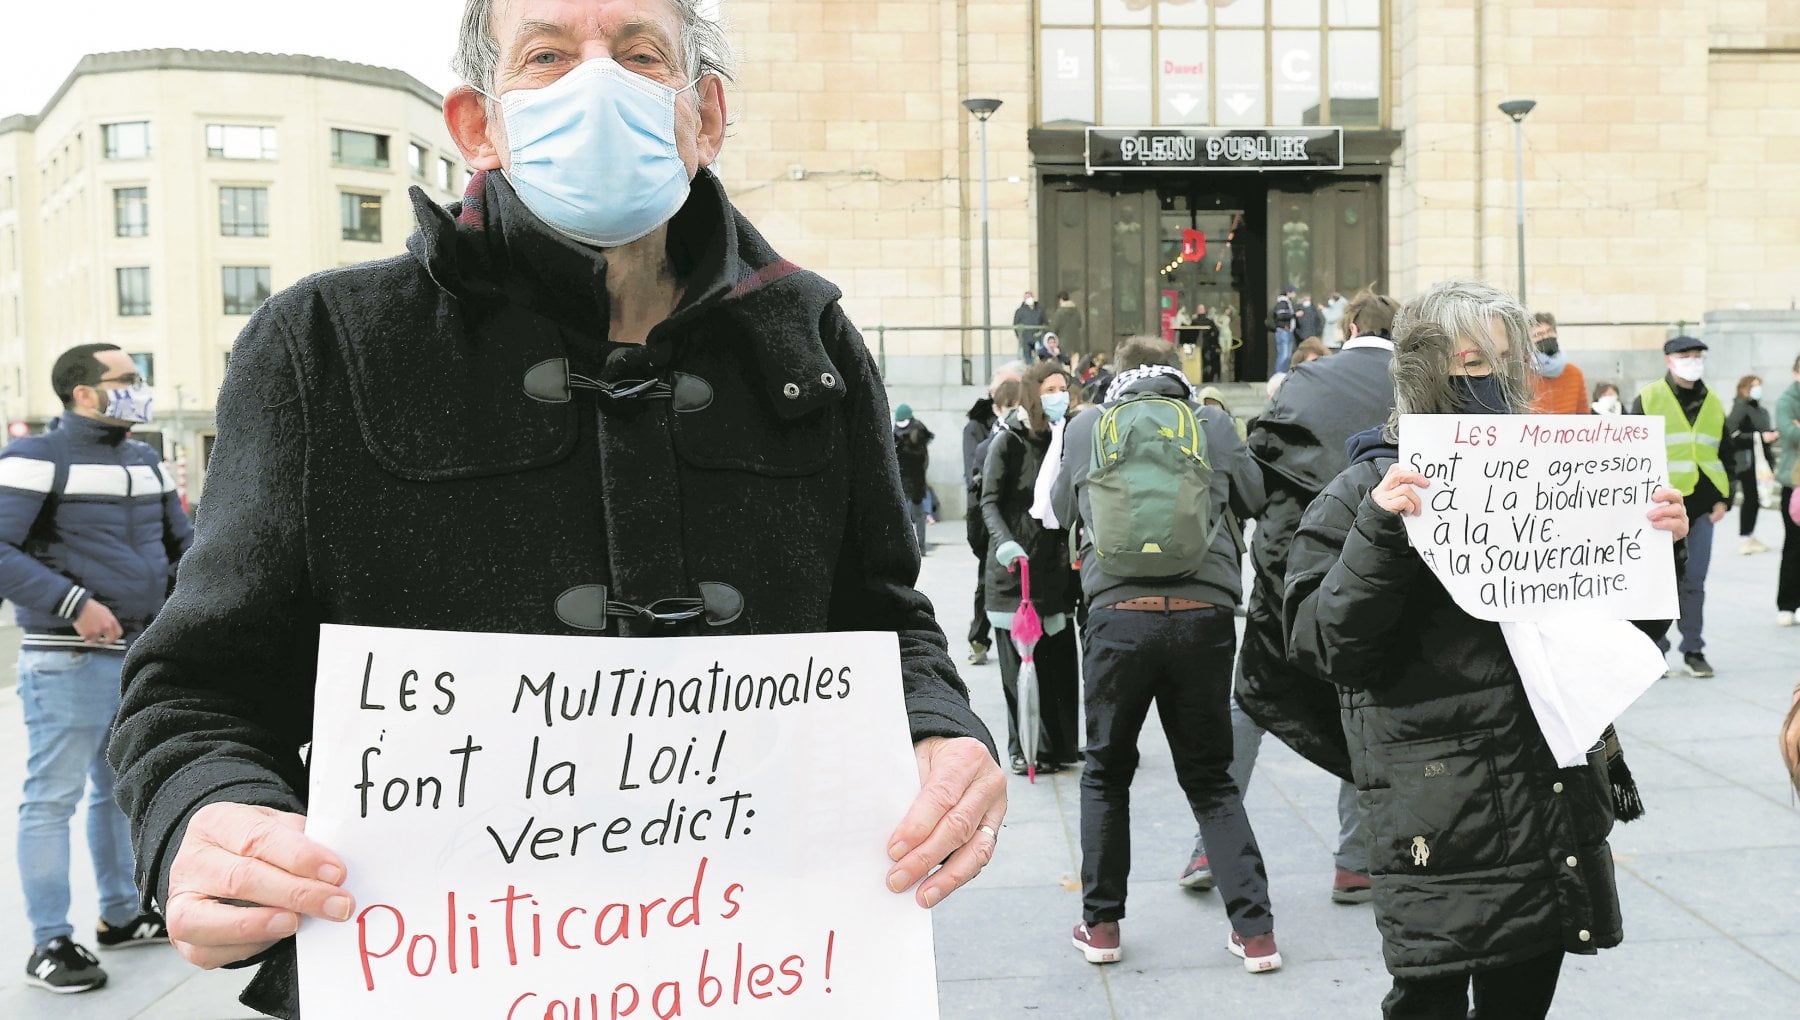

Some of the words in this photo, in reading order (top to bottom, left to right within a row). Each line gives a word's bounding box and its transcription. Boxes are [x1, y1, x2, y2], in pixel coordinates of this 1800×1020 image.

[1120, 136, 1196, 161] PLEIN
[1206, 136, 1310, 161] PUBLIEK
[1483, 458, 1530, 482] une
[1548, 453, 1652, 487] agression
[1431, 482, 1458, 512] à
[1433, 514, 1451, 546] à
[1464, 513, 1489, 546] la
[1449, 548, 1471, 576] la
[1480, 571, 1628, 609] alimentaire.
[353, 734, 483, 819] font
[525, 735, 577, 800] la
[357, 856, 744, 992] Politicards
